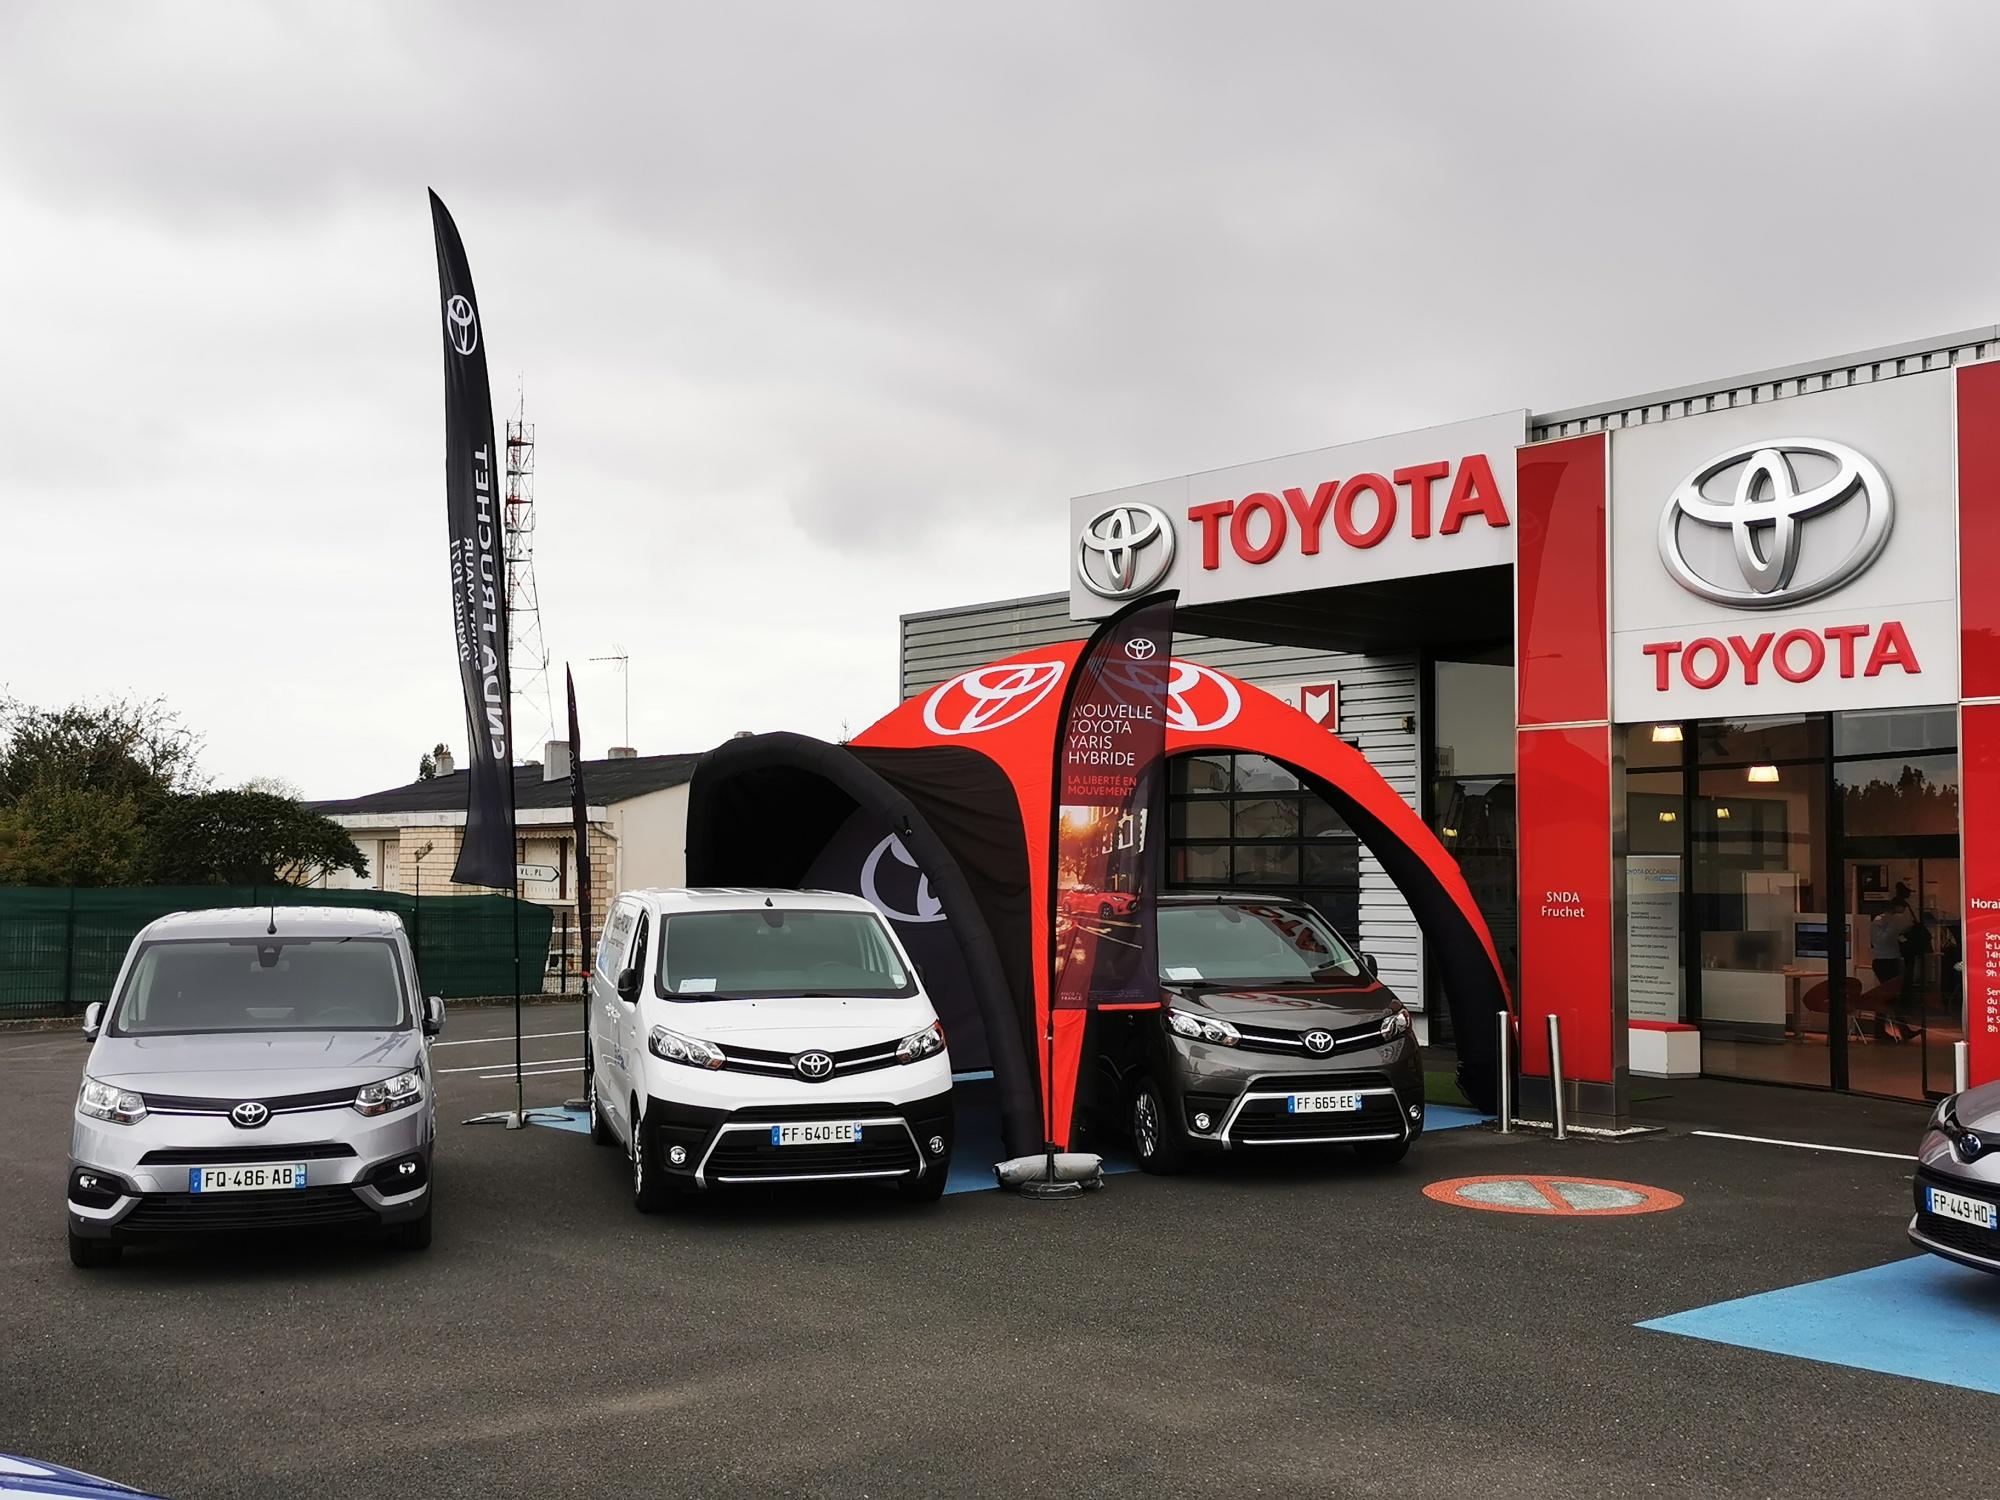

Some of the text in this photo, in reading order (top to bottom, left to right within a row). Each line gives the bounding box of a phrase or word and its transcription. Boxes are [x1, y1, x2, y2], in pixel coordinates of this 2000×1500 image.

[1188, 454, 1511, 571] TOYOTA
[1643, 621, 1922, 692] TOYOTA
[1073, 703, 1153, 719] NOUVELLE
[1072, 719, 1132, 735] TOYOTA
[1069, 735, 1113, 749] YARIS
[1068, 751, 1136, 767] HYBRIDE
[1067, 774, 1137, 787] LA LIBERTÉ EN
[1067, 785, 1134, 797] MOUVEMENT
[1546, 891, 1580, 903] SNDA
[1541, 905, 1585, 918] Fruchet
[1986, 960, 1997, 968] du
[1985, 969, 1997, 977] 9h
[1986, 997, 1998, 1005] du
[1987, 1006, 1998, 1014] 8h
[1987, 1024, 1999, 1033] 8h
[1297, 1095, 1354, 1110] FF-665-EE
[783, 1125, 852, 1142] FF-640-EE
[205, 1168, 293, 1188] FQ-486-AB
